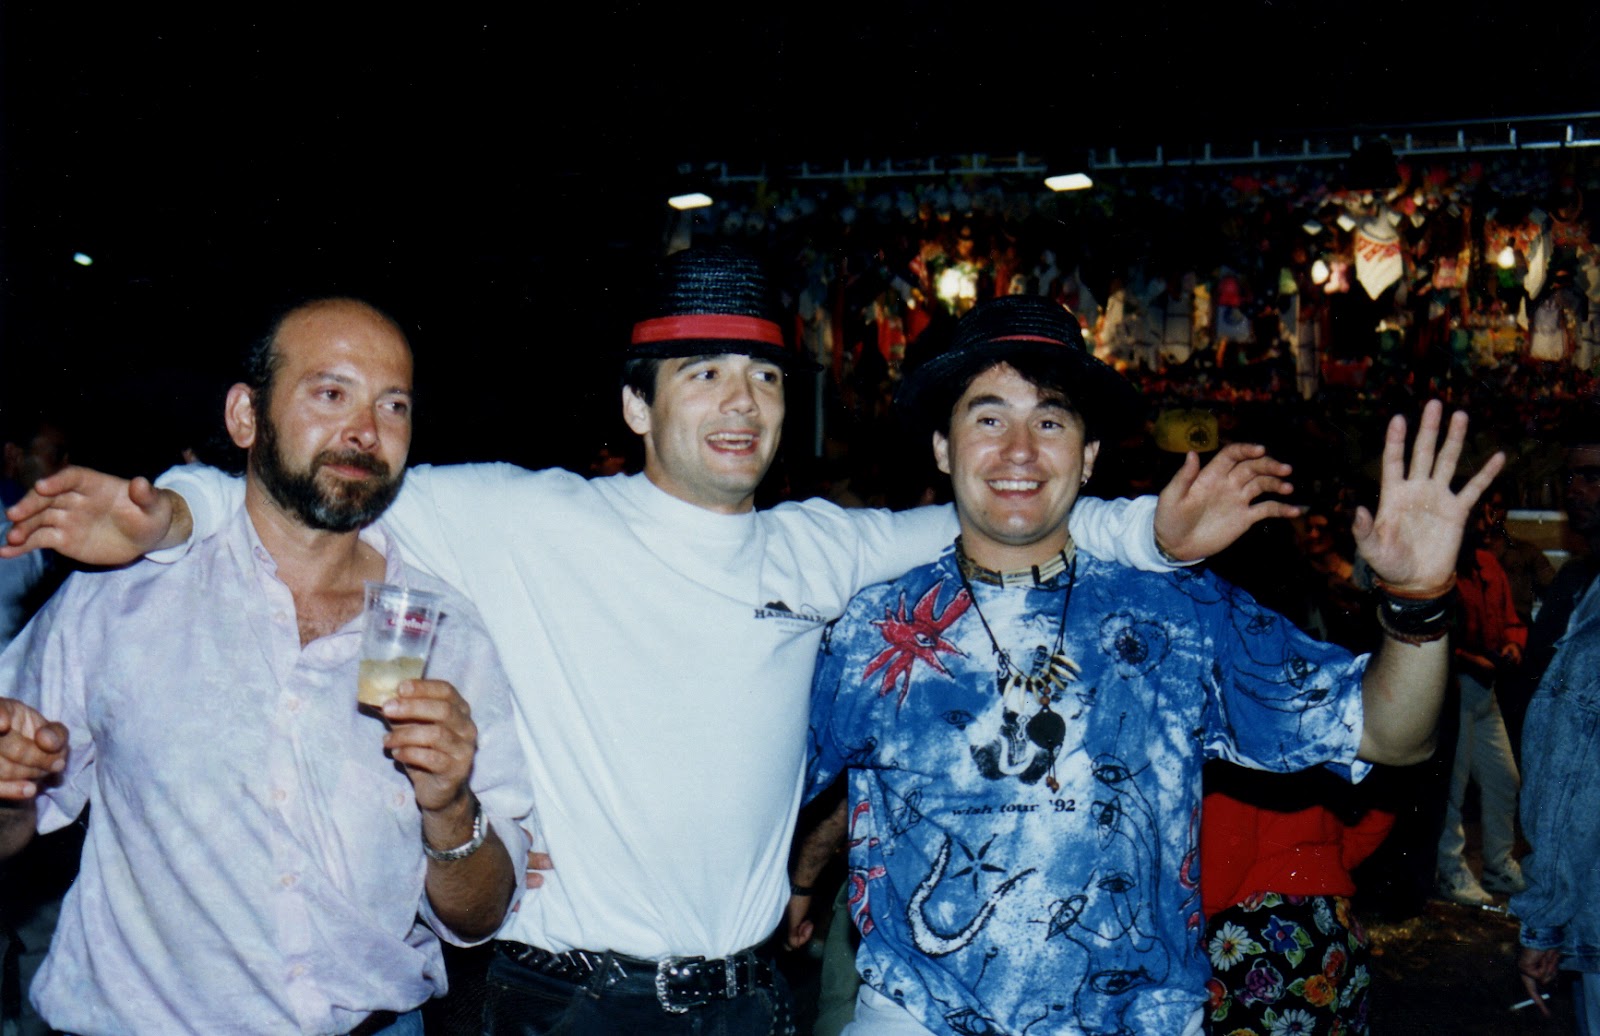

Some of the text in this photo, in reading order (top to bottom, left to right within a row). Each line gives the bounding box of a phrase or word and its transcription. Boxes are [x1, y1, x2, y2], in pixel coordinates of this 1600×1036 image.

[951, 799, 1076, 816] wish tour '92
